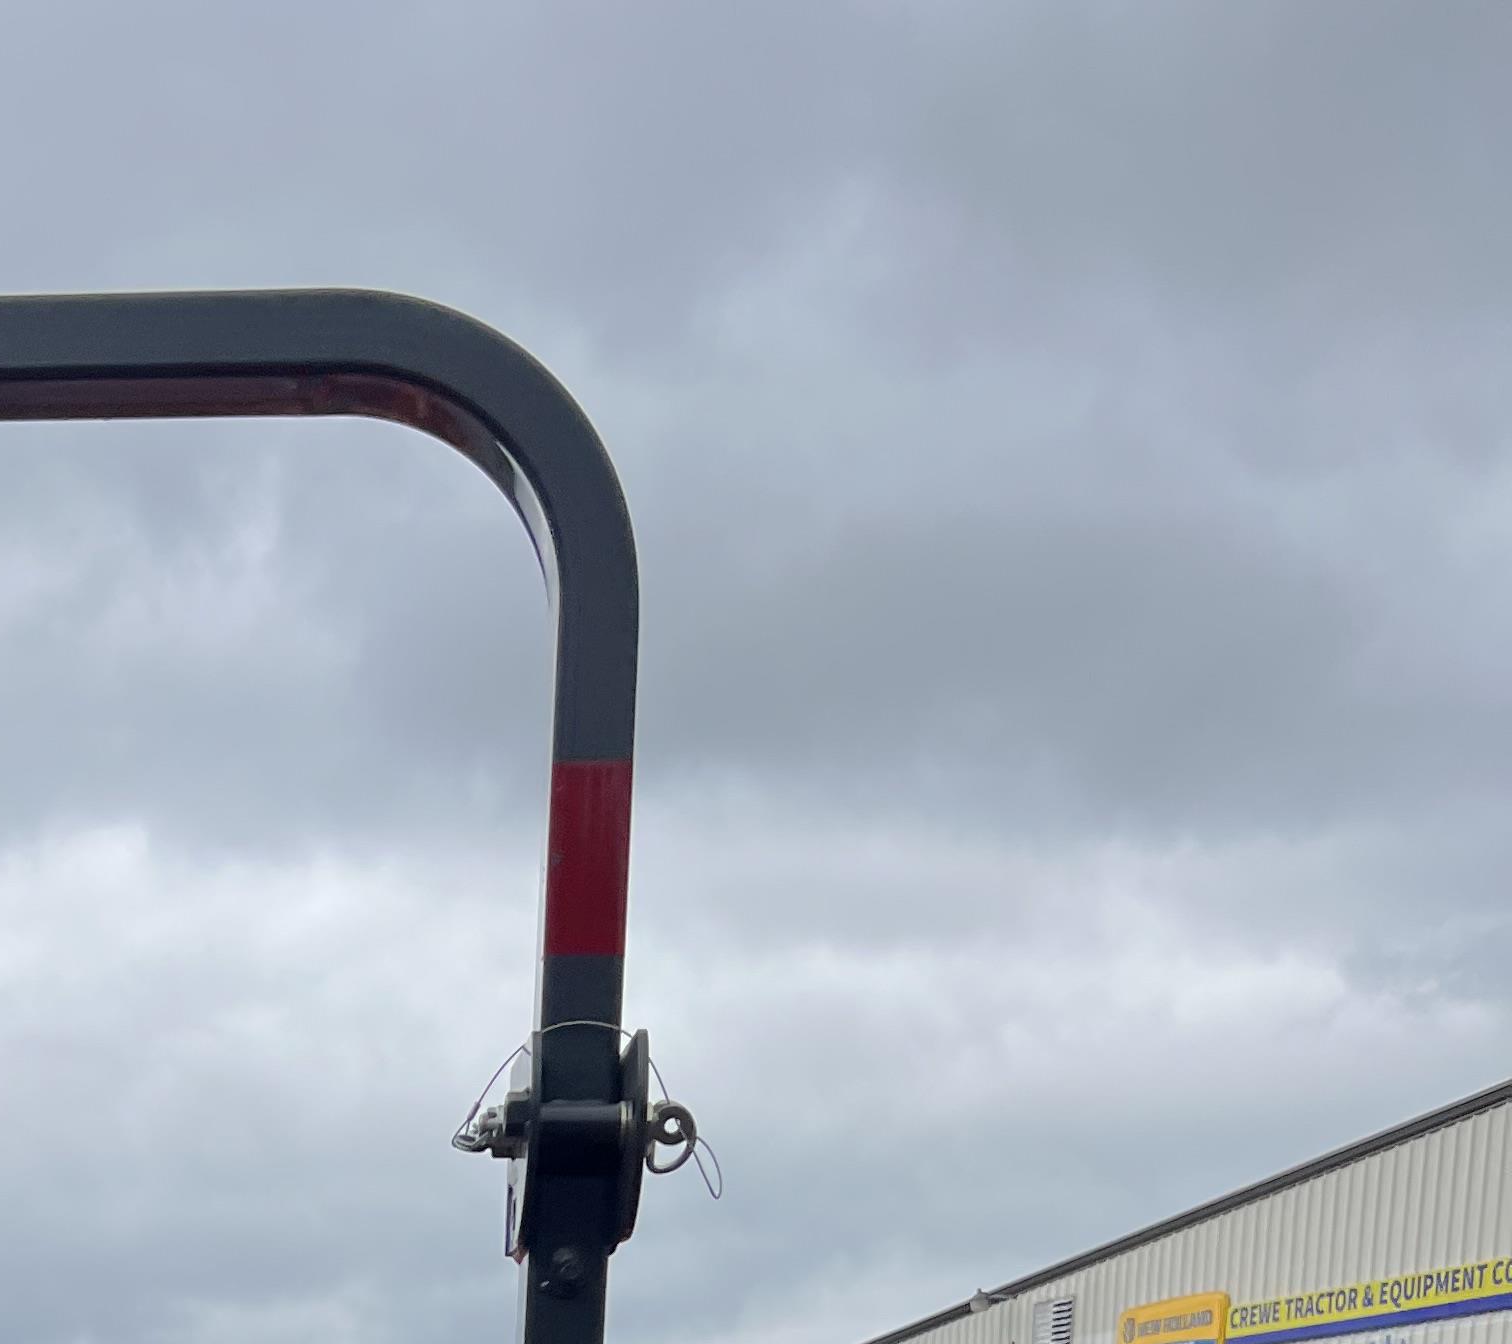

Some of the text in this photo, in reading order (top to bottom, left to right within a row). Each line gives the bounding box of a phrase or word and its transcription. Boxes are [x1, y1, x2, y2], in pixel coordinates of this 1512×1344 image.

[1230, 1301, 1281, 1329] CREWE
[1285, 1288, 1358, 1321] TRACTOR
[1362, 1284, 1374, 1307] &
[1379, 1263, 1488, 1308] EQUIPMENT
